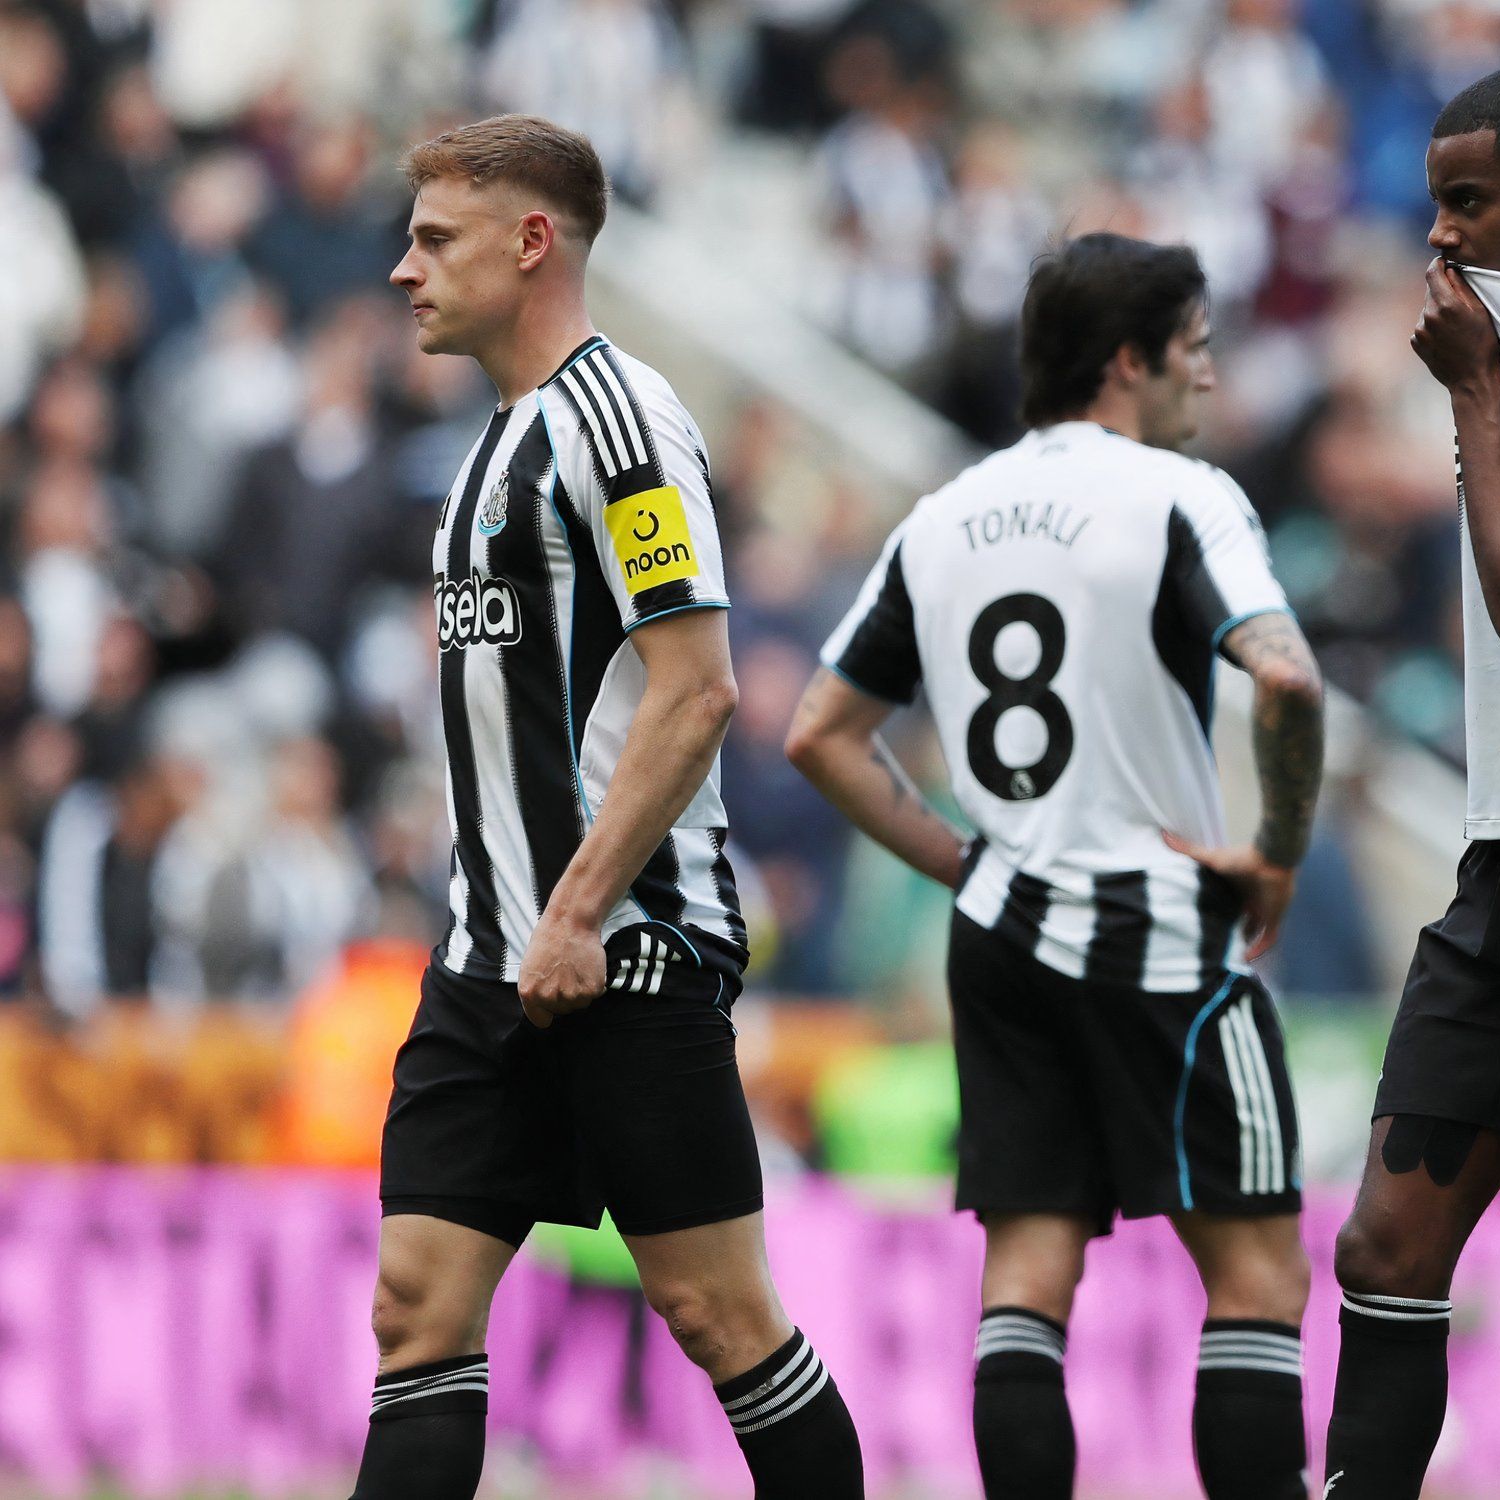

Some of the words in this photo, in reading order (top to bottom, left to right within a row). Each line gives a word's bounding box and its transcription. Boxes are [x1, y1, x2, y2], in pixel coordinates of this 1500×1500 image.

[961, 502, 1090, 550] TONALI
[624, 542, 690, 579] noon
[439, 581, 515, 642] sela
[967, 593, 1074, 802] 8
